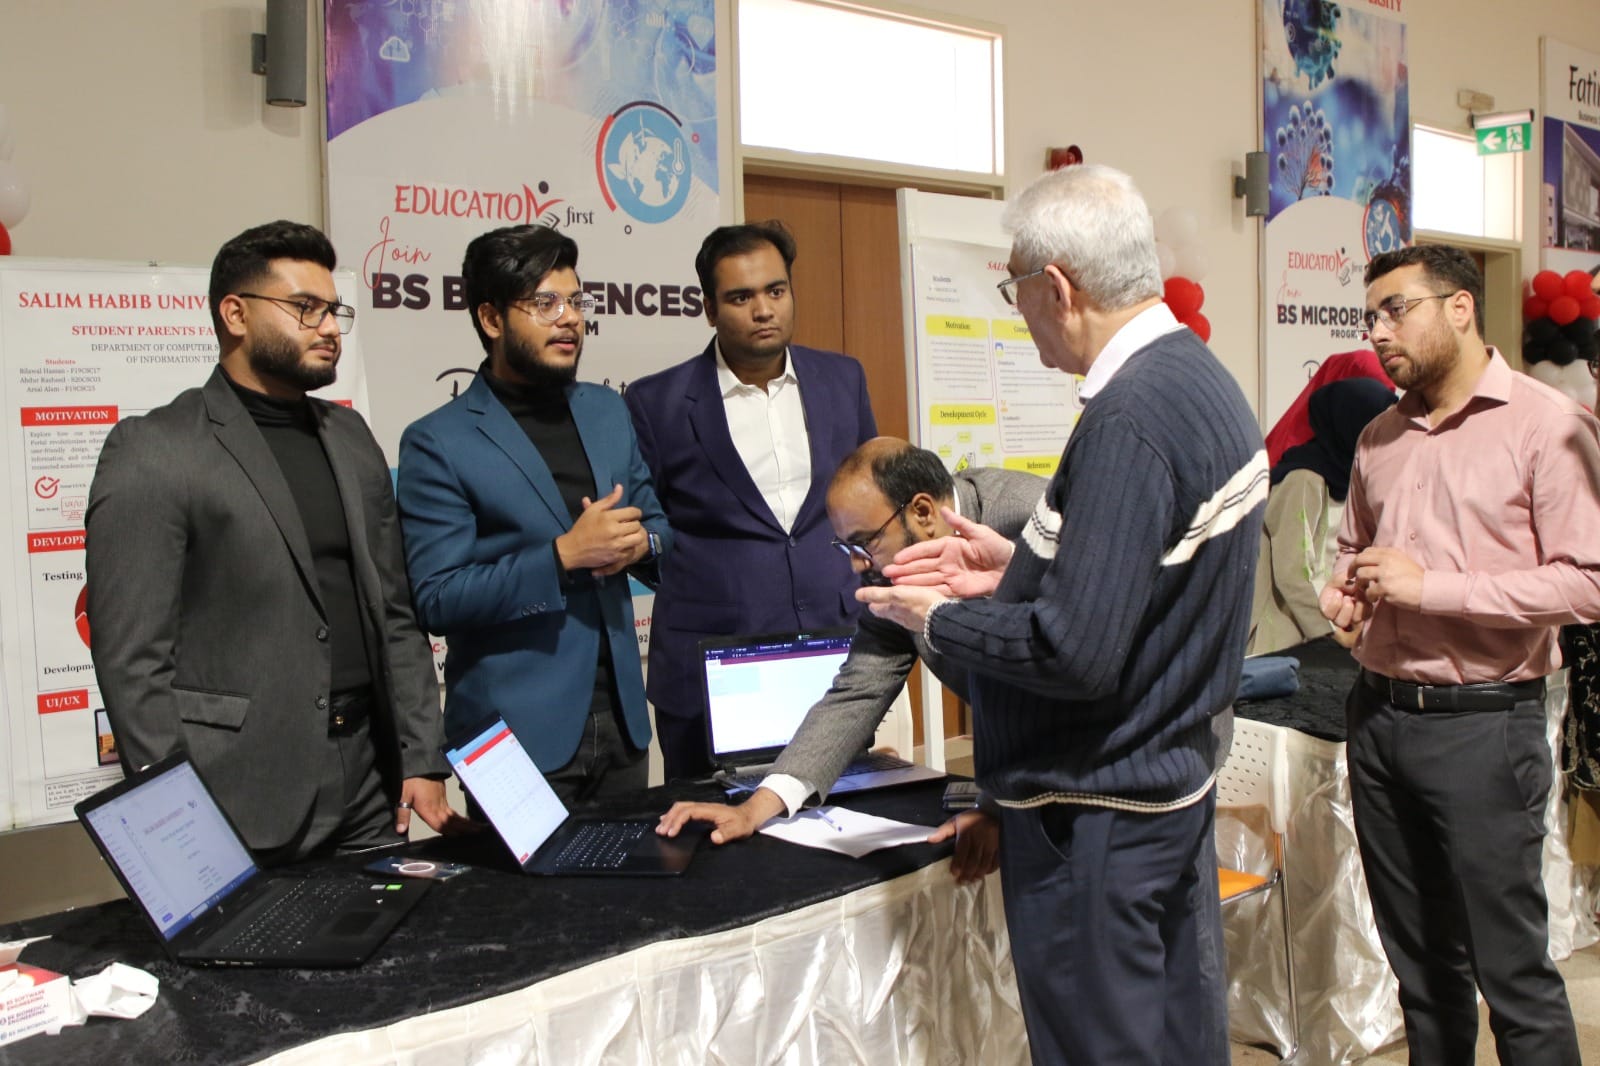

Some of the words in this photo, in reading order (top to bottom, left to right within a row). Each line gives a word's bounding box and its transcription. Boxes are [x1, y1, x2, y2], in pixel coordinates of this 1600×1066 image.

[394, 184, 564, 224] EDUCATION
[564, 206, 594, 226] first
[363, 216, 431, 290] Join
[987, 261, 1009, 272] SALI
[1288, 250, 1350, 277] EDUCATION
[372, 272, 431, 310] BS
[19, 291, 82, 308] SALIM
[89, 293, 151, 310] HABIB
[158, 295, 210, 310] UNIV
[1277, 304, 1298, 325] BS
[1301, 305, 1363, 326] MICROBI
[72, 325, 134, 336] STUDENT
[138, 326, 196, 336] PARENTS
[199, 326, 215, 336] FA
[1330, 329, 1358, 339] PROGR
[91, 343, 152, 352] DEPARTMENT
[153, 343, 166, 352] OF
[166, 343, 213, 352] COMPUTER
[126, 355, 139, 364] OF
[140, 355, 202, 364] INFORMATION
[203, 355, 219, 364] TEC
[35, 410, 109, 421] MOTIVATION
[43, 571, 83, 582] Testing
[45, 695, 80, 708] UI/UX
